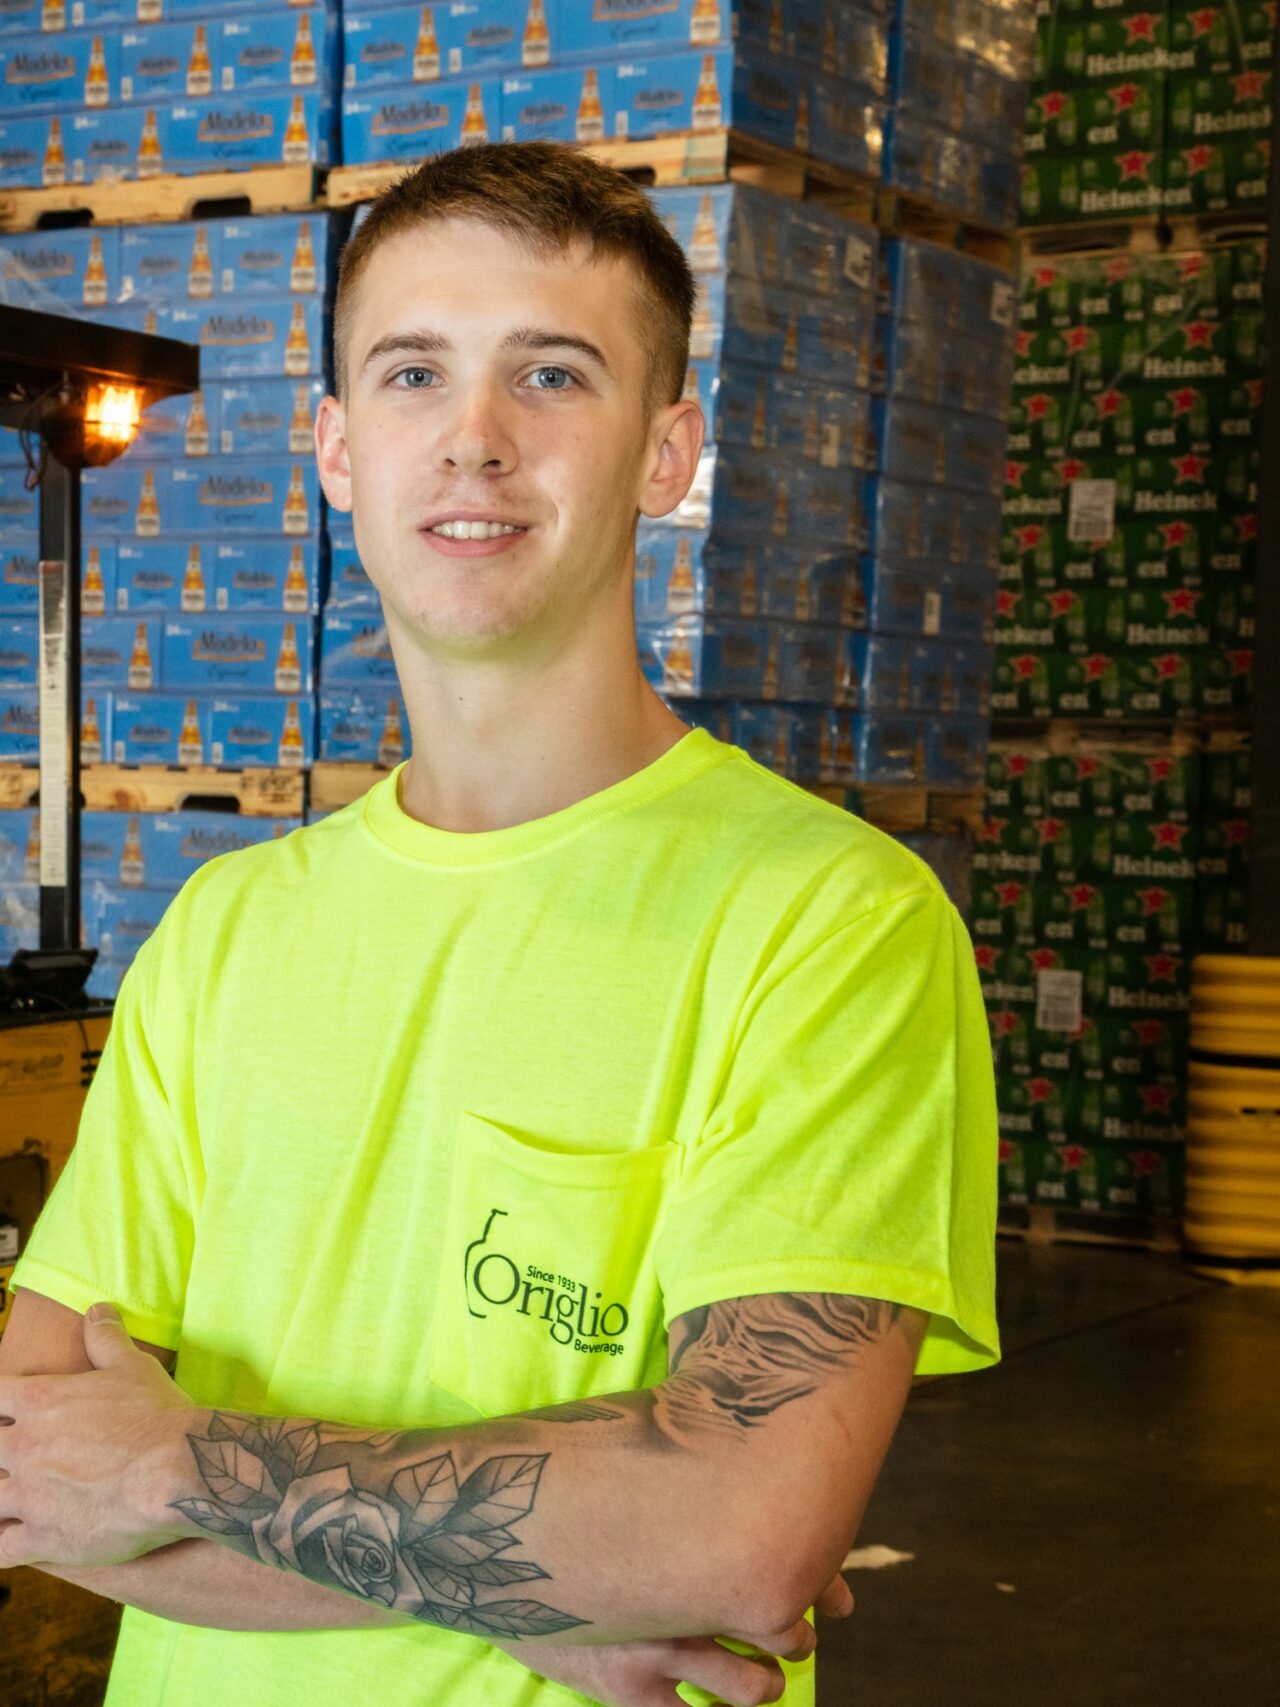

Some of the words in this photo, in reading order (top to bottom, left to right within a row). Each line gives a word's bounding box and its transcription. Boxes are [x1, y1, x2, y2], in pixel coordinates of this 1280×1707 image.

[1087, 48, 1195, 77] Heineken
[207, 111, 266, 130] Modelo
[208, 315, 266, 335] Modelo
[201, 631, 258, 651] Modelo
[527, 1265, 554, 1283] Since
[557, 1275, 576, 1293] 1933
[473, 1254, 629, 1345] Origlio
[574, 1338, 624, 1356] Beverage
